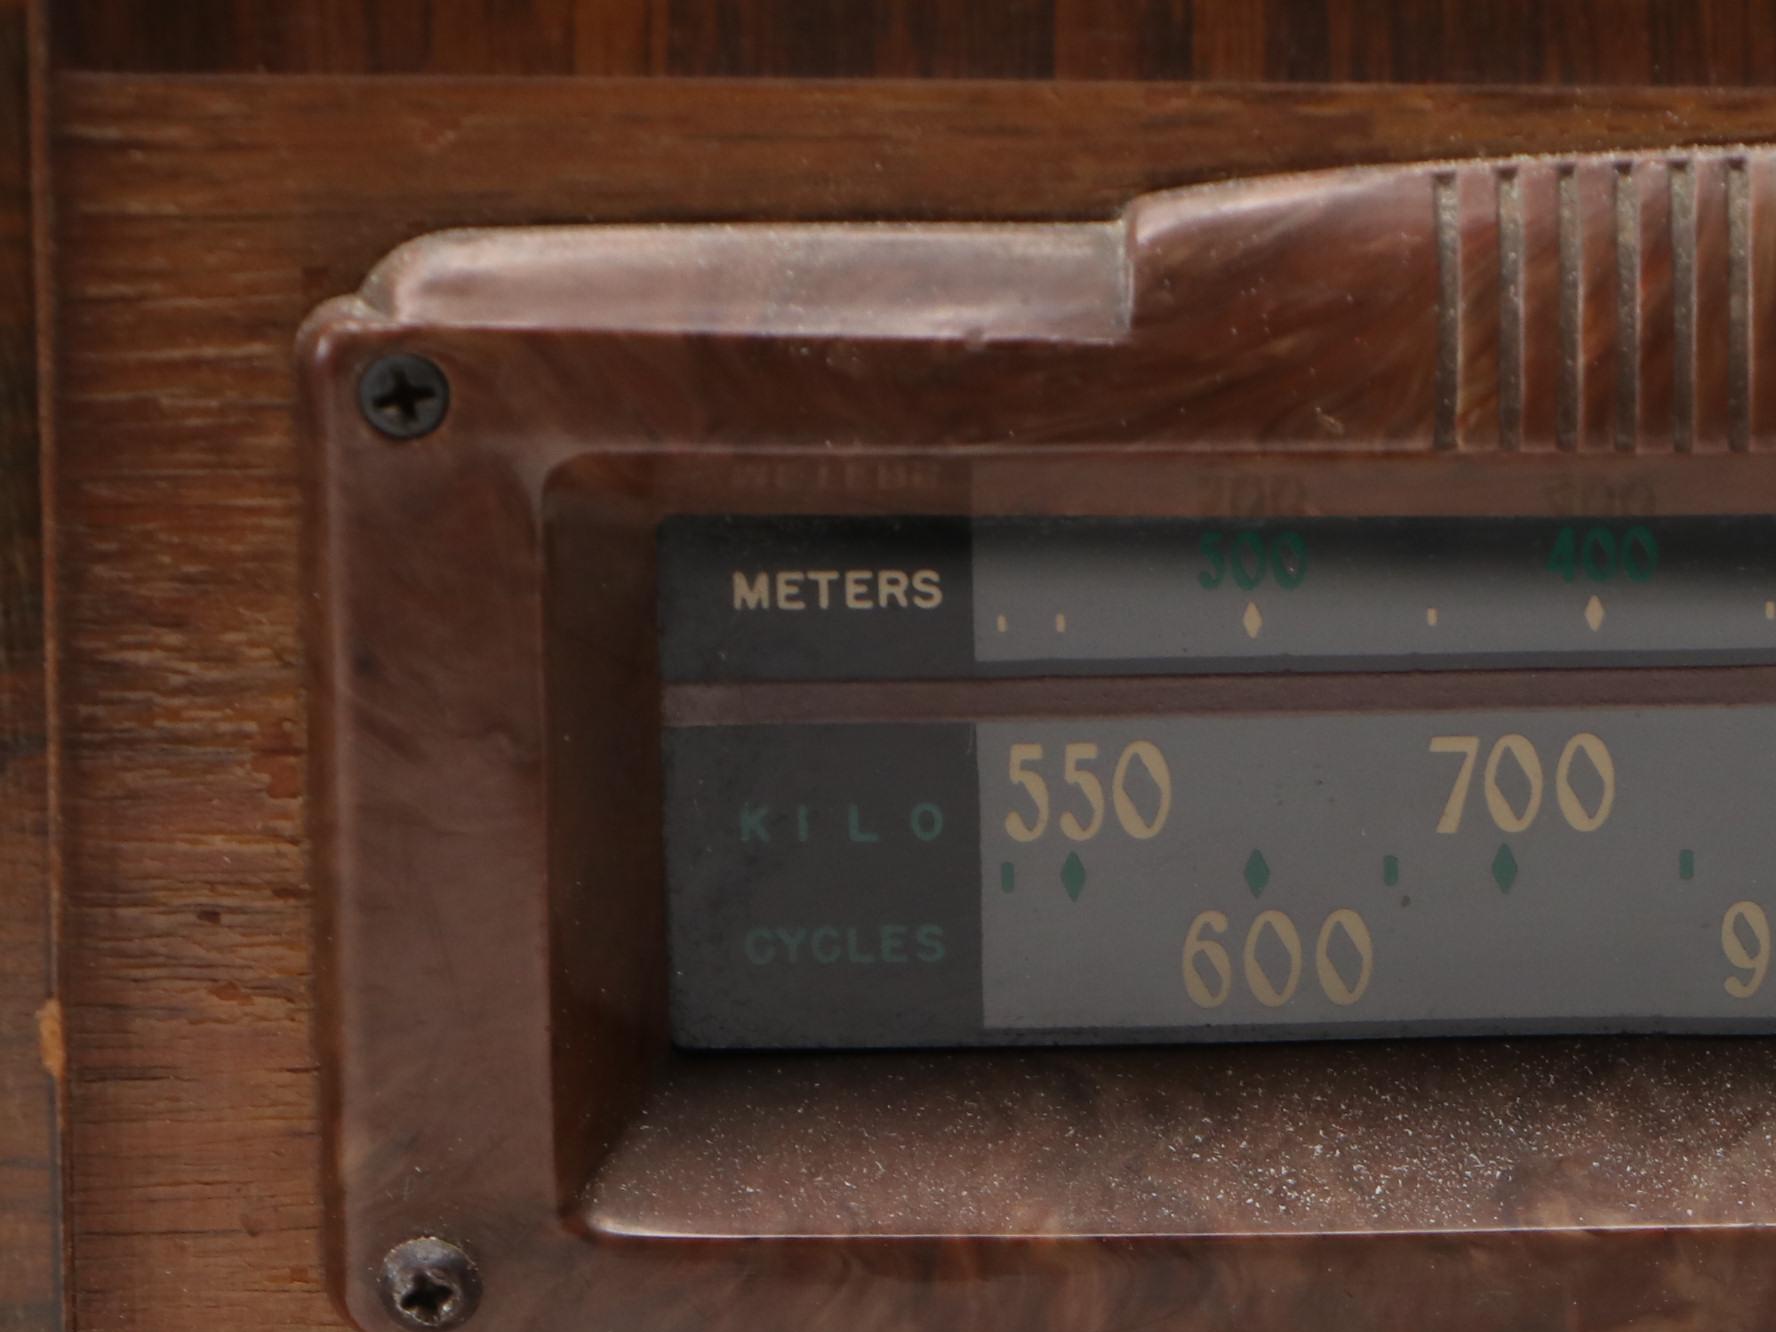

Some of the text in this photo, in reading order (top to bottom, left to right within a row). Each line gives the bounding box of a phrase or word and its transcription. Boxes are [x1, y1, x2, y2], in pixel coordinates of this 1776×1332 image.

[732, 570, 943, 610] METERS
[1198, 530, 1309, 592] 500
[1545, 525, 1659, 583] 400
[1004, 741, 1172, 842] 550
[1428, 733, 1615, 834] 700
[745, 925, 946, 964] CYCLES
[1182, 907, 1373, 1007] 600
